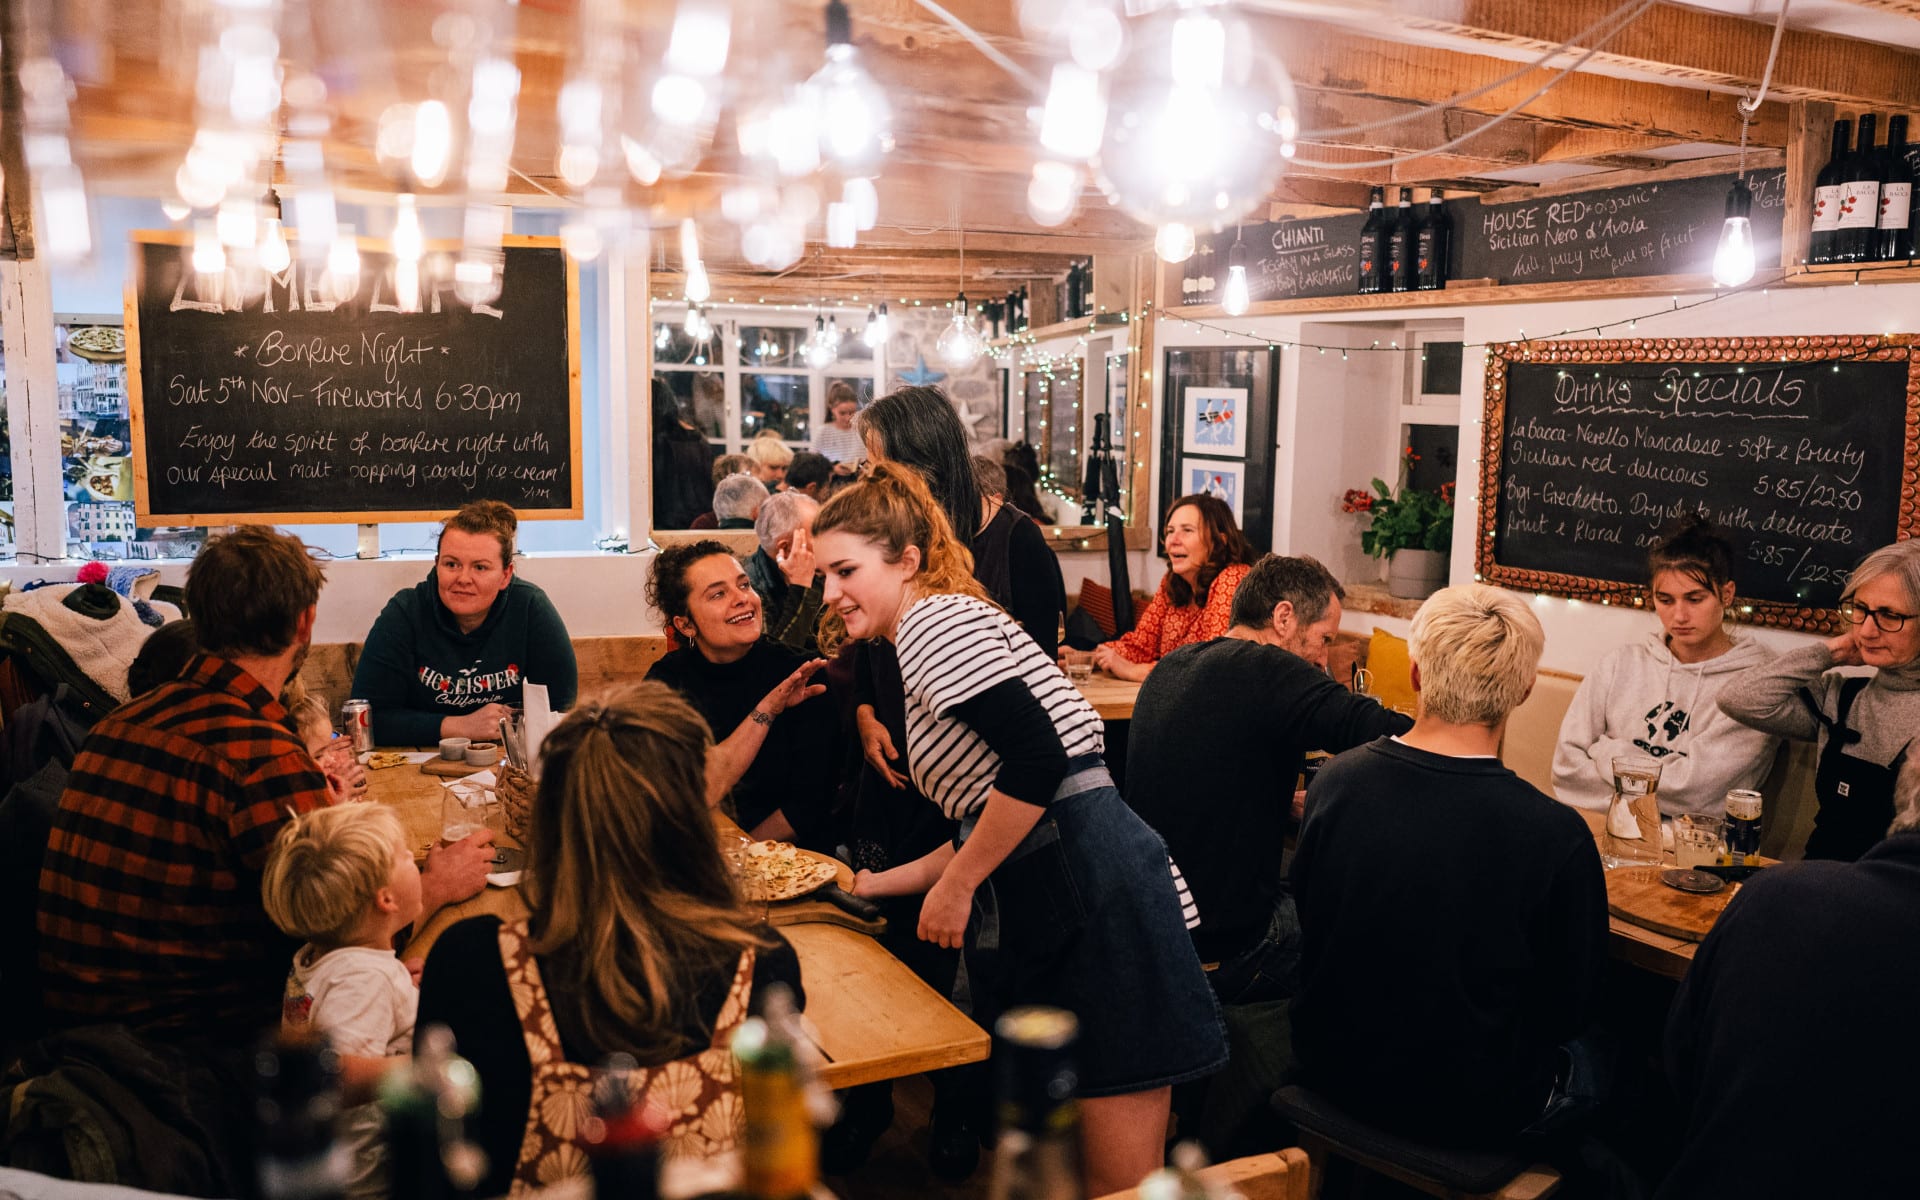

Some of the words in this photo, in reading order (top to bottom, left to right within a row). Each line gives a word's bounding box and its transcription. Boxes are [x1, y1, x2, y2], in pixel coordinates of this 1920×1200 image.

[1482, 207, 1540, 235] HOUSE
[1546, 201, 1585, 227] RED
[1272, 226, 1324, 249] CHIANTI
[1489, 230, 1540, 251] Sicilian
[1545, 227, 1578, 247] Nero
[1589, 242, 1611, 260] red
[1312, 252, 1321, 262] A
[1323, 244, 1356, 259] GLASS
[256, 330, 352, 368] Bonfire
[361, 332, 433, 384] Night
[168, 374, 211, 406] Sat
[310, 376, 422, 410] Fireworks
[1554, 374, 1632, 405] Drinks
[1654, 367, 1806, 414] Specials
[180, 425, 236, 463] Enjoy
[246, 430, 278, 449] the
[284, 430, 337, 456] spirit
[349, 431, 371, 456] of
[380, 430, 451, 453] bonfire
[456, 431, 509, 465] night
[513, 431, 549, 455] with
[1510, 440, 1576, 467] Sicilian
[1634, 425, 1724, 457] Mascalese
[167, 466, 202, 485] our
[208, 461, 278, 489] special
[289, 461, 333, 480] malt
[1506, 511, 1549, 537] fruit
[1574, 518, 1623, 544] floral
[1629, 492, 1663, 529] Dry
[1718, 505, 1755, 531] with
[1762, 509, 1852, 545] delicate
[420, 666, 518, 695] HOLLISTER
[435, 694, 504, 707] California
